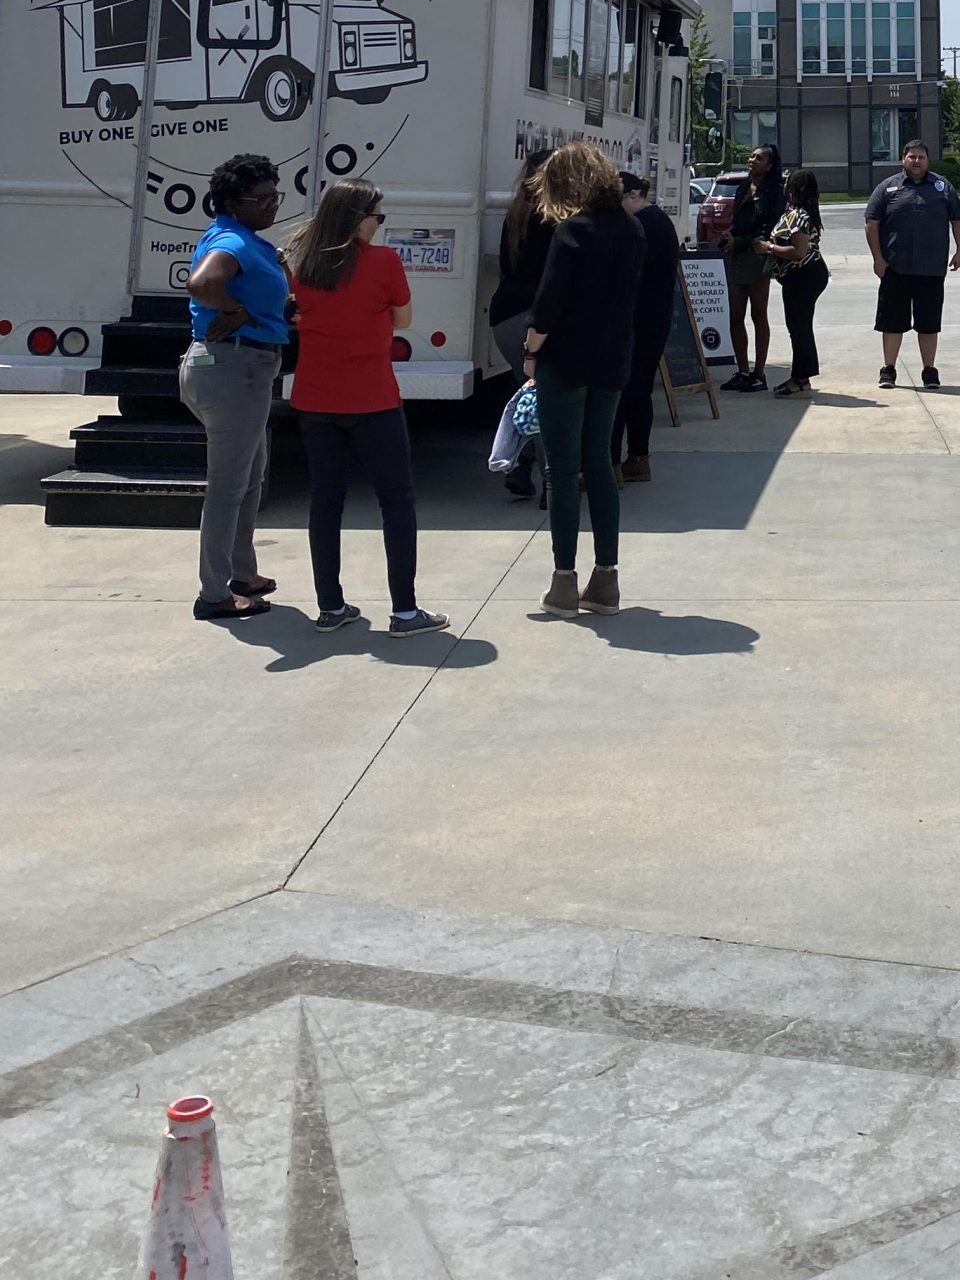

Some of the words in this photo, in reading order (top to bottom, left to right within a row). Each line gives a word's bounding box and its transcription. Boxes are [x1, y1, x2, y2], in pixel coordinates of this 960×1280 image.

[59, 130, 93, 144] BUY
[98, 126, 135, 142] ONE
[150, 122, 188, 138] GIVE
[192, 118, 229, 134] ONE
[150, 241, 197, 255] HopeTr
[684, 272, 698, 280] JOY
